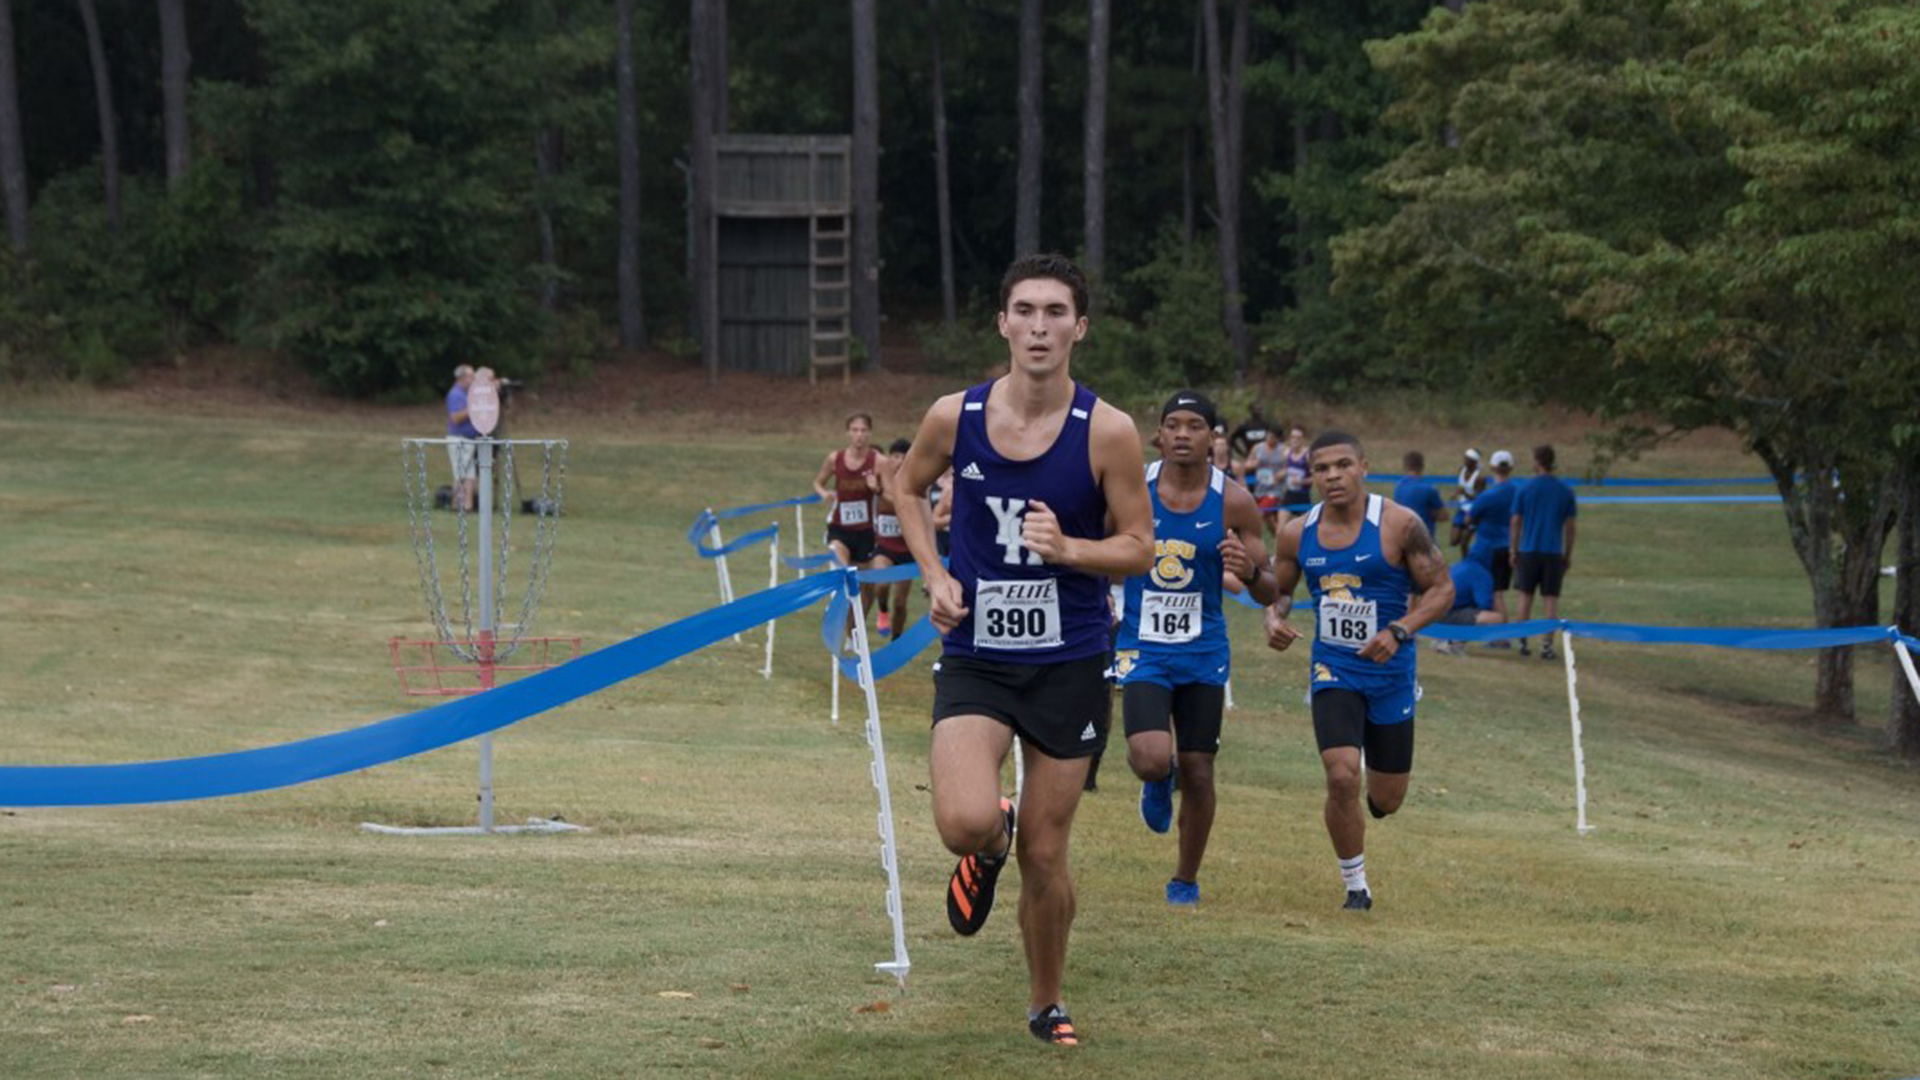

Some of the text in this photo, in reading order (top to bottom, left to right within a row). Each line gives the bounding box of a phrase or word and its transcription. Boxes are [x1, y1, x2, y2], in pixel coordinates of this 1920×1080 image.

[1006, 583, 1054, 599] ELITE
[1164, 595, 1197, 608] ELITE
[1340, 603, 1374, 615] ELITE
[986, 607, 1047, 638] 390
[1150, 611, 1191, 635] 164
[1328, 617, 1368, 641] 163
